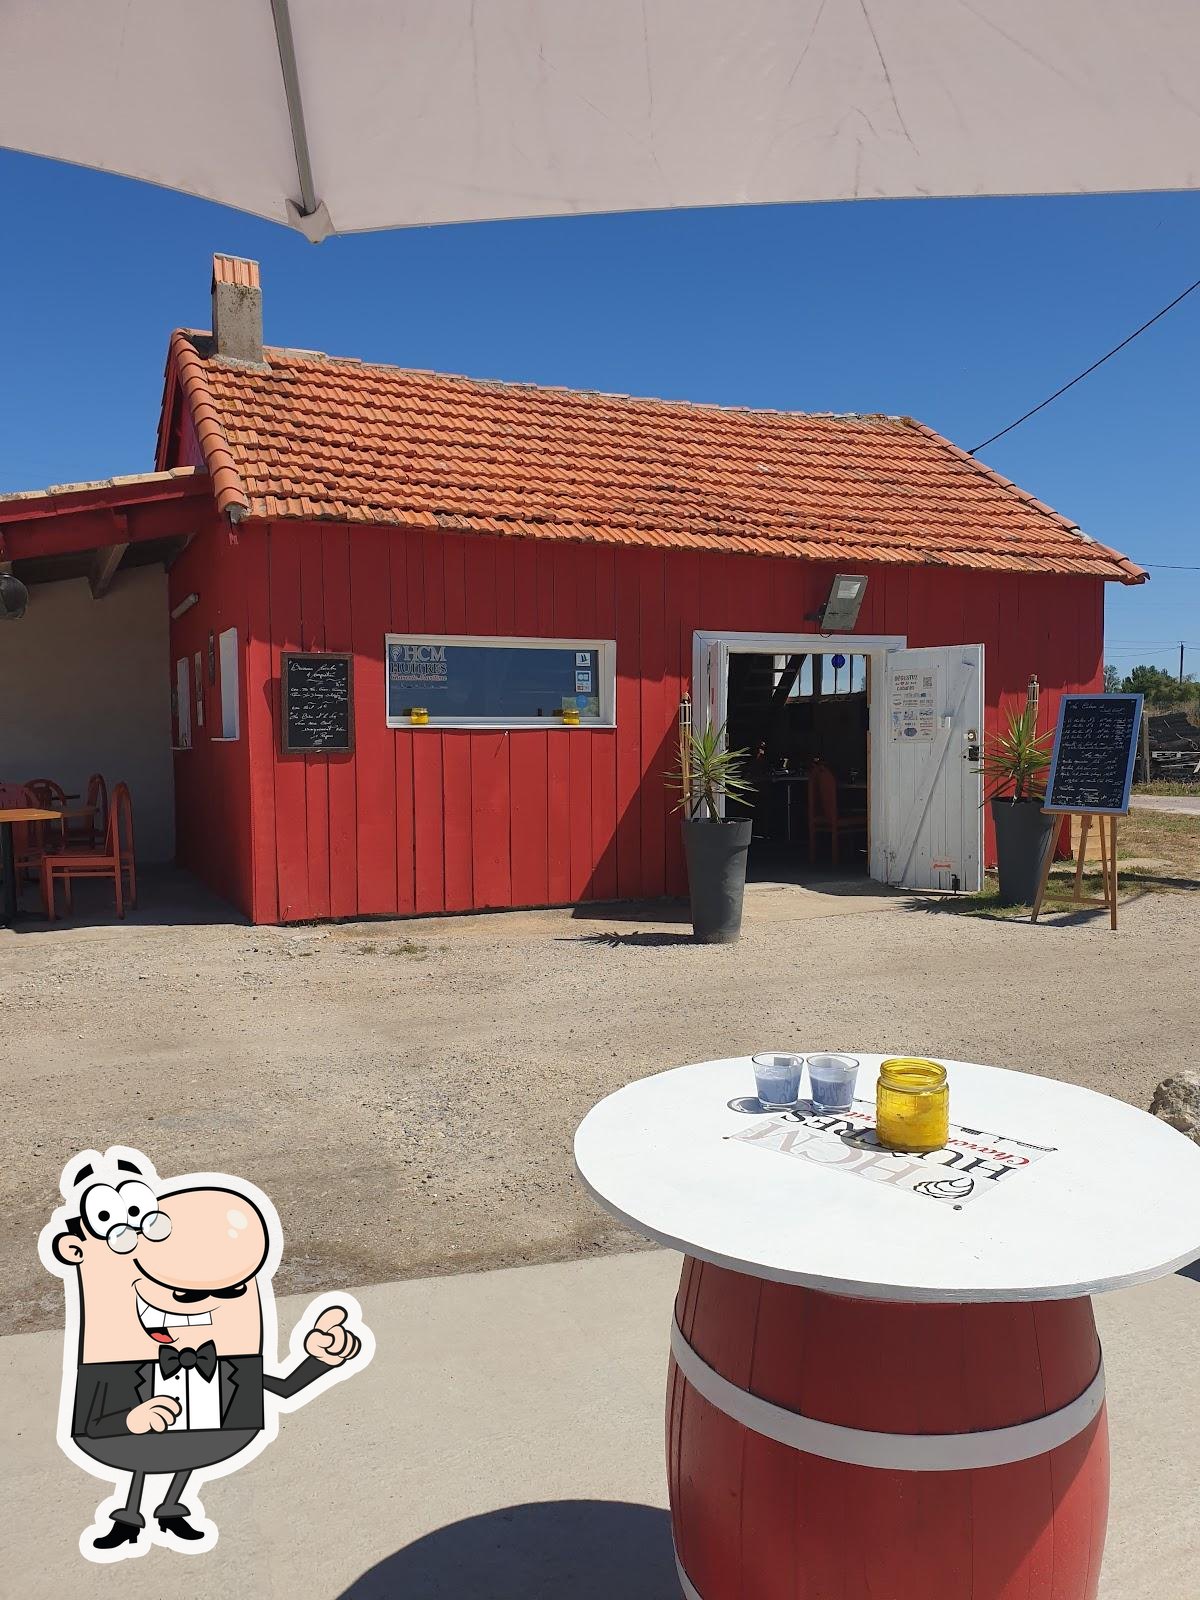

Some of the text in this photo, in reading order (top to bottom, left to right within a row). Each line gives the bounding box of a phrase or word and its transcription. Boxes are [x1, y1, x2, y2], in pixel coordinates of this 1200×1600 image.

[403, 646, 446, 661] HCM
[742, 1121, 929, 1187] HCM
[781, 1108, 1018, 1182] HURES
